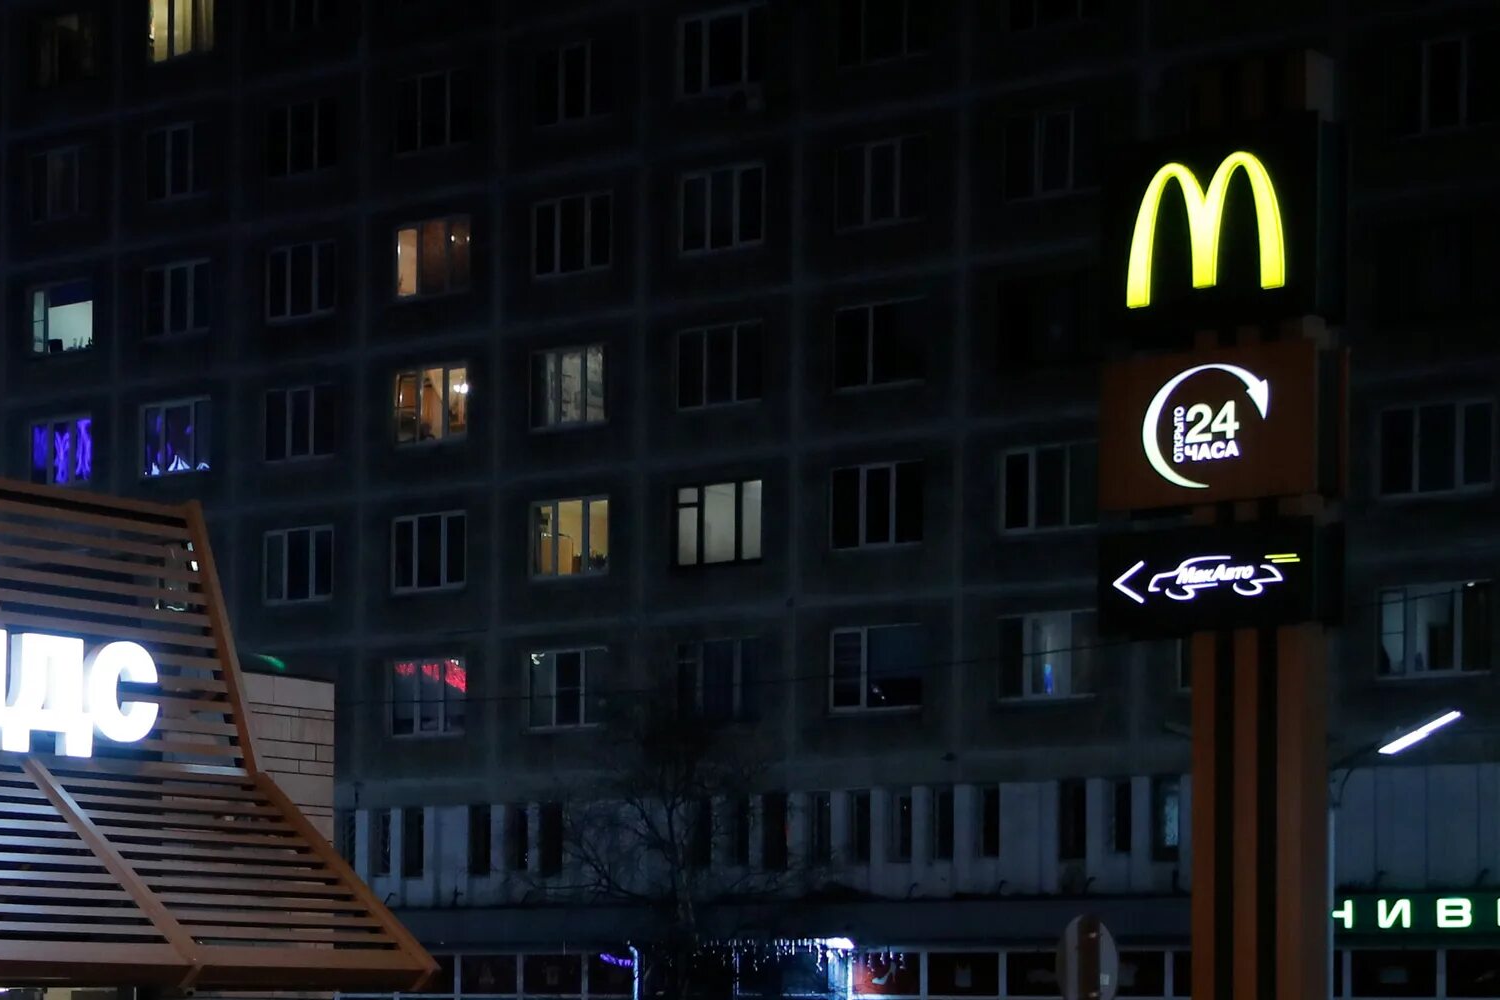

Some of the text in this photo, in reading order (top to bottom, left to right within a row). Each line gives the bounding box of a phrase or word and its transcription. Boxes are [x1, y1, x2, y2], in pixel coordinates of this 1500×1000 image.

[1173, 406, 1185, 463] ОТКРЫТО
[1185, 400, 1239, 444] 24
[1184, 440, 1240, 461] ЧАСА
[1175, 564, 1255, 584] МакАвто
[1332, 897, 1500, 930] НИВ
